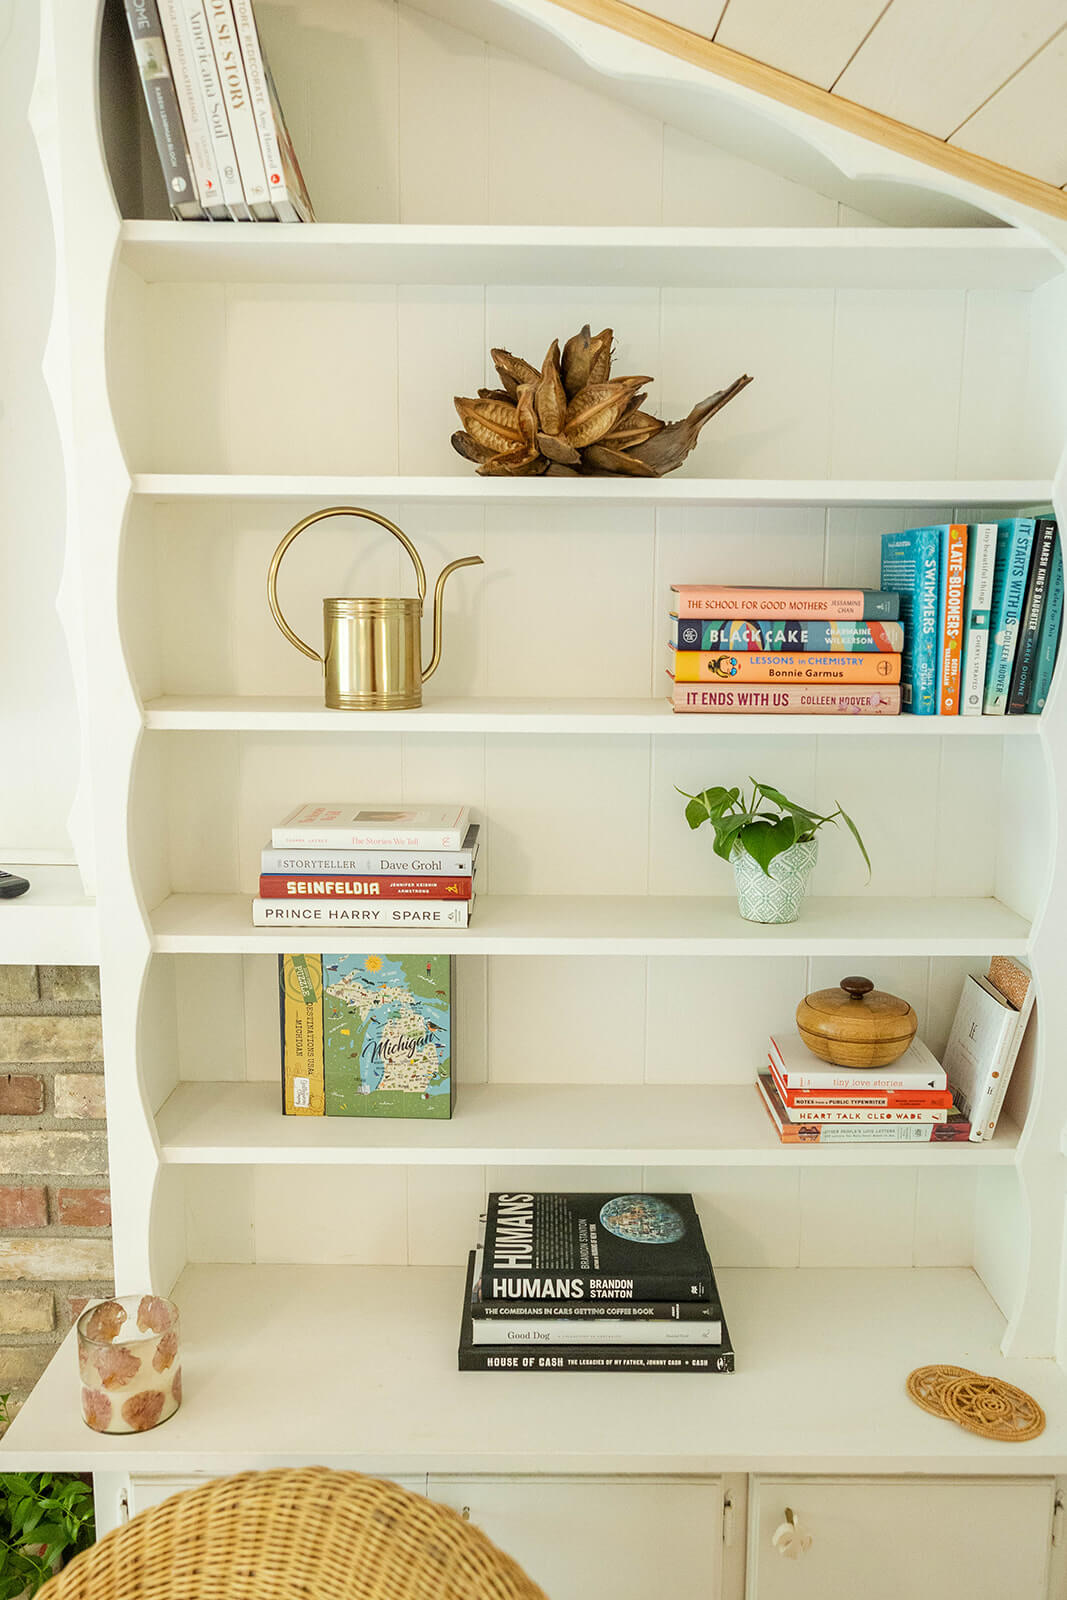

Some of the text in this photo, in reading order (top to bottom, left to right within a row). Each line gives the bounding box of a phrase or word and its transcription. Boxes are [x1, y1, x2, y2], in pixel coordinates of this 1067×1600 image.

[190, 10, 228, 138] Americana Soul
[222, 51, 245, 110] STORY
[245, 35, 265, 103] REDECORATE
[981, 544, 990, 580] beautiful
[946, 543, 964, 637] LATE BLOOMERS
[1028, 526, 1055, 631] THE MARSH KING'S DAUGHTER
[688, 600, 828, 610] THE SCHOOL FOR GOOD MOTHERS
[922, 560, 937, 634] SWIMMERS
[995, 523, 1032, 693] IT STARTS WITH US COLLEEN HOOVER
[710, 630, 808, 643] BLACK CAKE
[750, 657, 794, 665] LESSONS
[808, 657, 864, 665] CHEMISTRY
[1018, 638, 1033, 696] KAREN DIONNE
[769, 669, 844, 678] Bonnie Garmus
[971, 662, 979, 690] STRAYED
[687, 692, 871, 706] IT ENDS WITH US COLLEEN HOOVER
[352, 837, 366, 845] The
[366, 837, 393, 845] Stories
[283, 860, 356, 869] STORYTELLER
[380, 860, 409, 870] Dave
[411, 860, 442, 870] Grohl
[286, 881, 380, 895] SEINFELDIA
[265, 908, 441, 920] PRINCE HARRY SPARE
[294, 965, 310, 997] PUZZLE
[306, 1001, 314, 1057] DESTINATIONS
[361, 1032, 435, 1064] Michigan
[833, 1079, 849, 1087] tiny
[852, 1079, 871, 1087] love
[493, 1194, 534, 1269] HUMANS
[578, 1219, 590, 1270] BRANDON STANTON
[493, 1278, 584, 1298] HUMANS
[589, 1279, 634, 1289] BRANDON
[590, 1289, 633, 1298] STANTON
[507, 1331, 531, 1340] Good
[533, 1331, 551, 1341] Dog
[487, 1357, 519, 1367] HOUSE
[522, 1357, 535, 1367] OF
[538, 1357, 564, 1367] CASH
